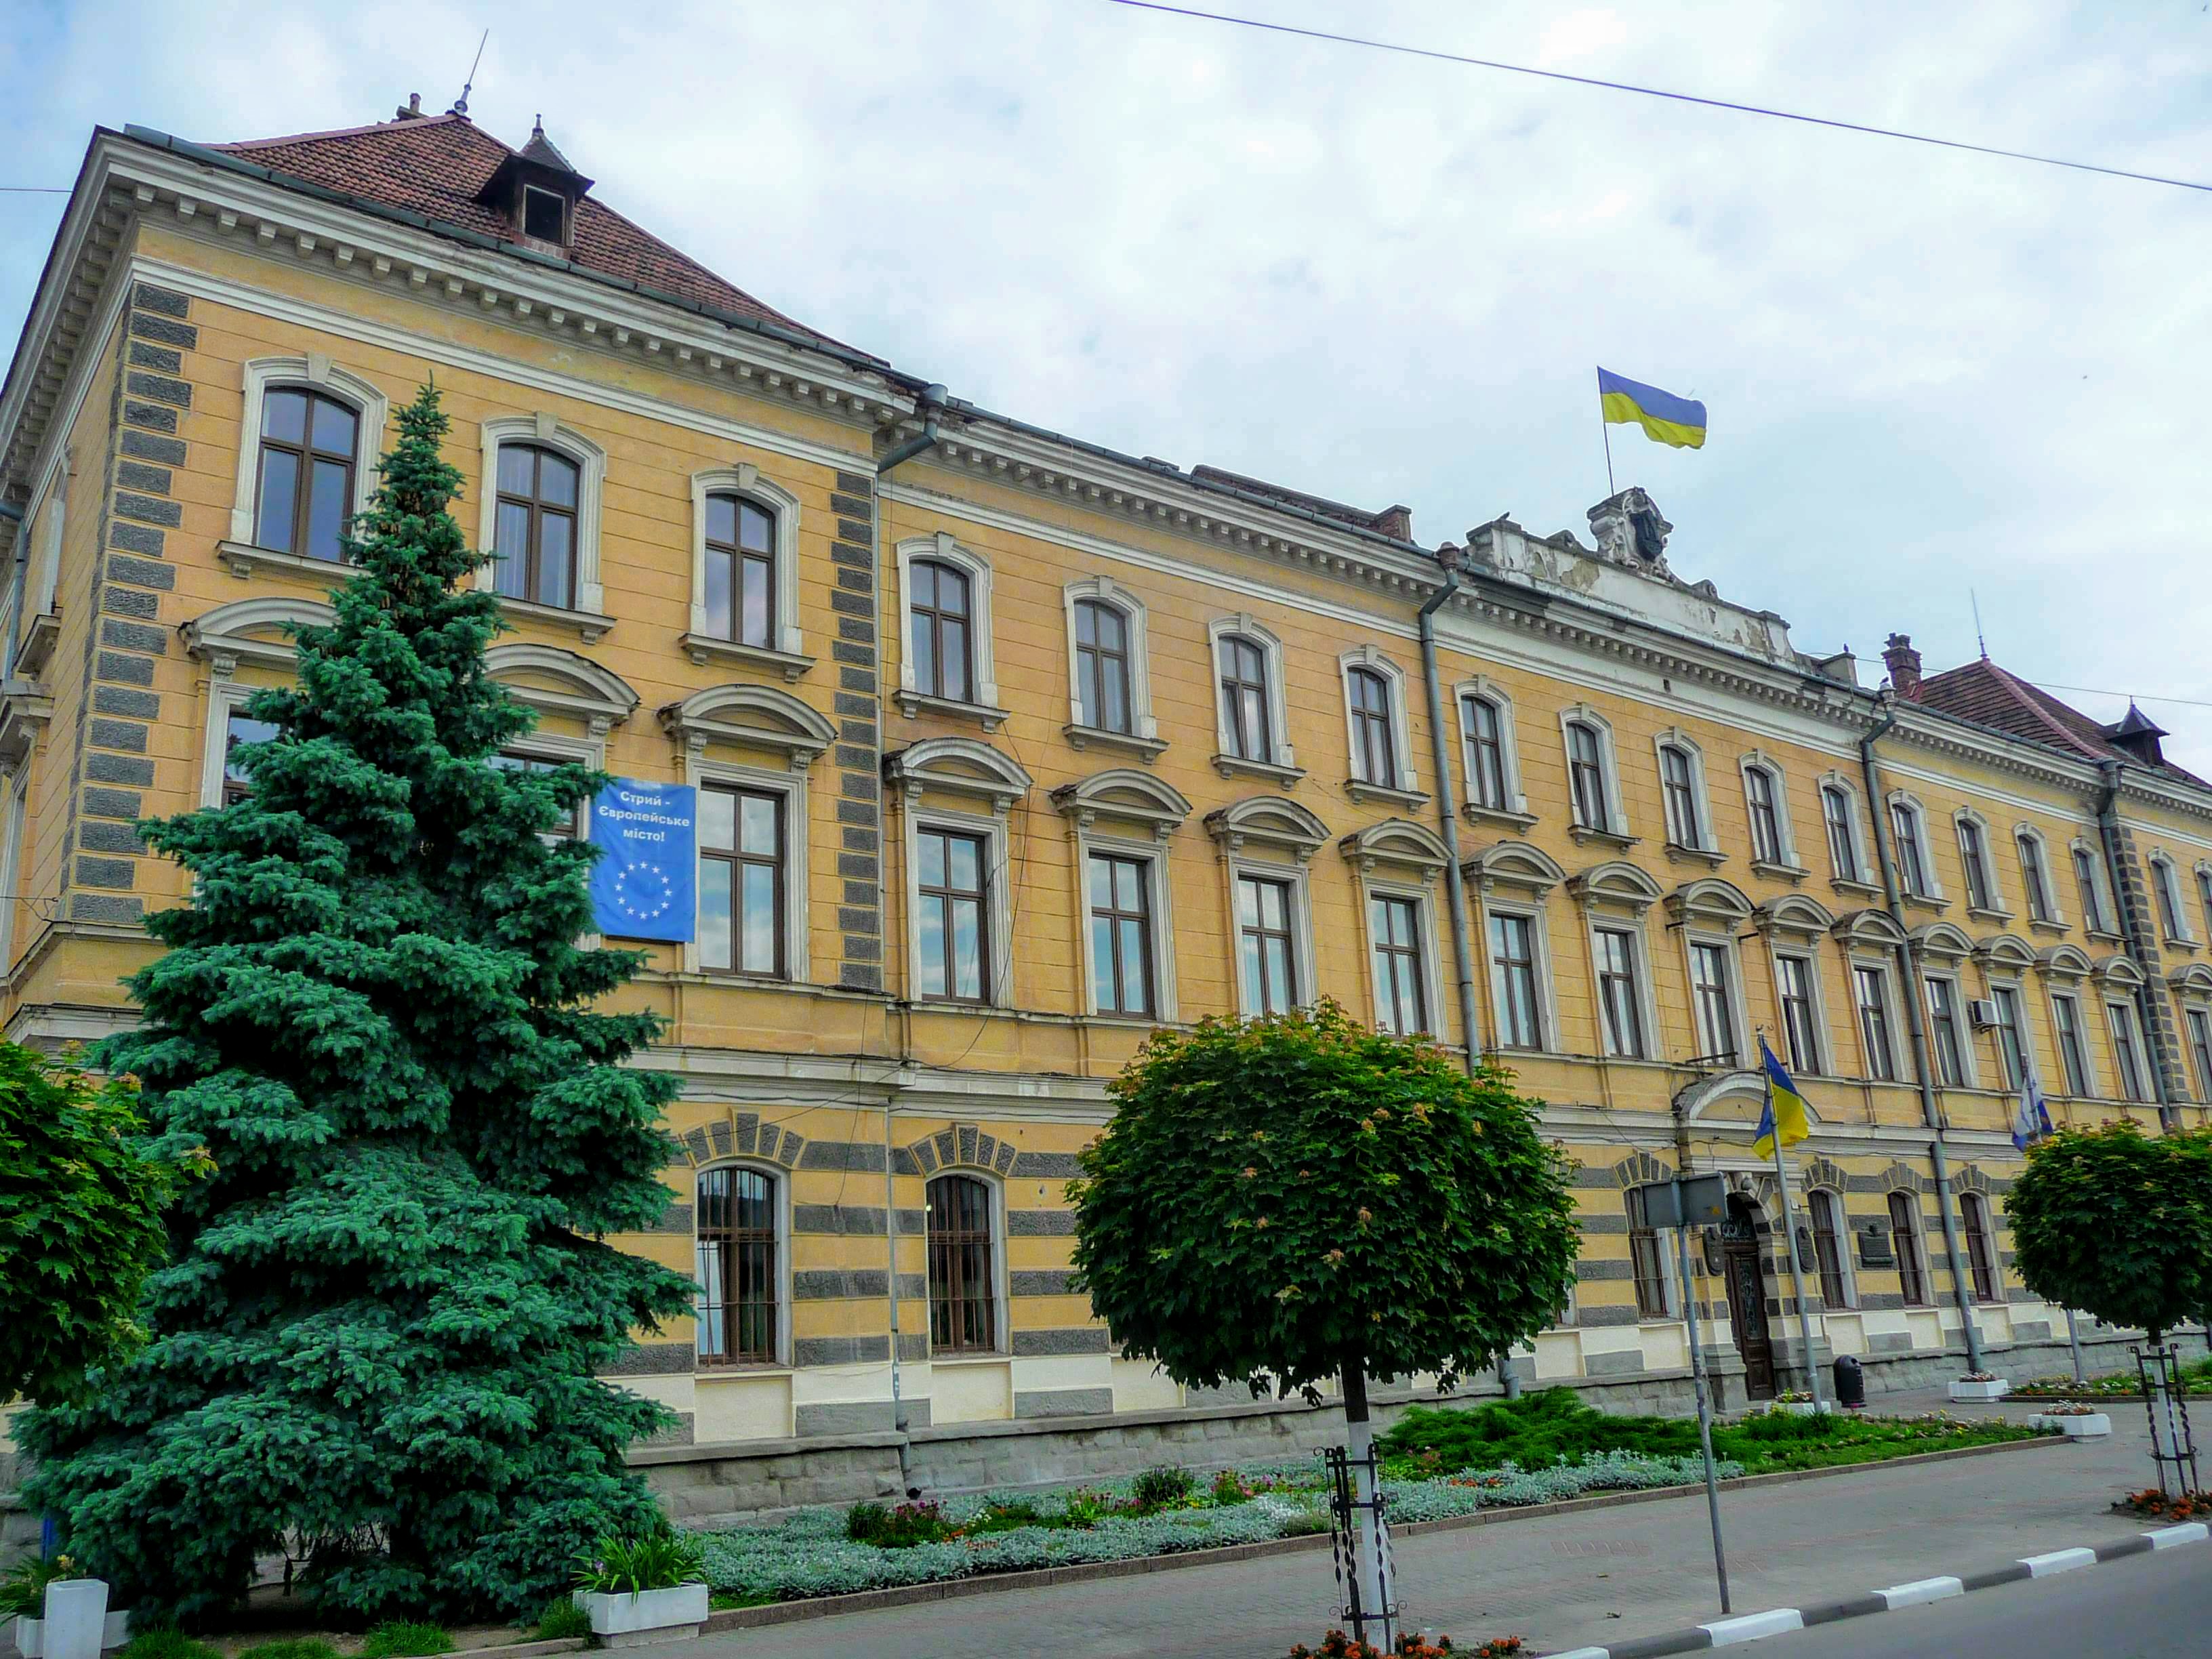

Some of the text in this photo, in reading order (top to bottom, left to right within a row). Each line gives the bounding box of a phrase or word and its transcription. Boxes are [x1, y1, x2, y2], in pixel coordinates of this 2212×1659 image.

[620, 791, 661, 806] Стрий
[599, 806, 689, 827] Європейське
[623, 828, 665, 842] місто!
